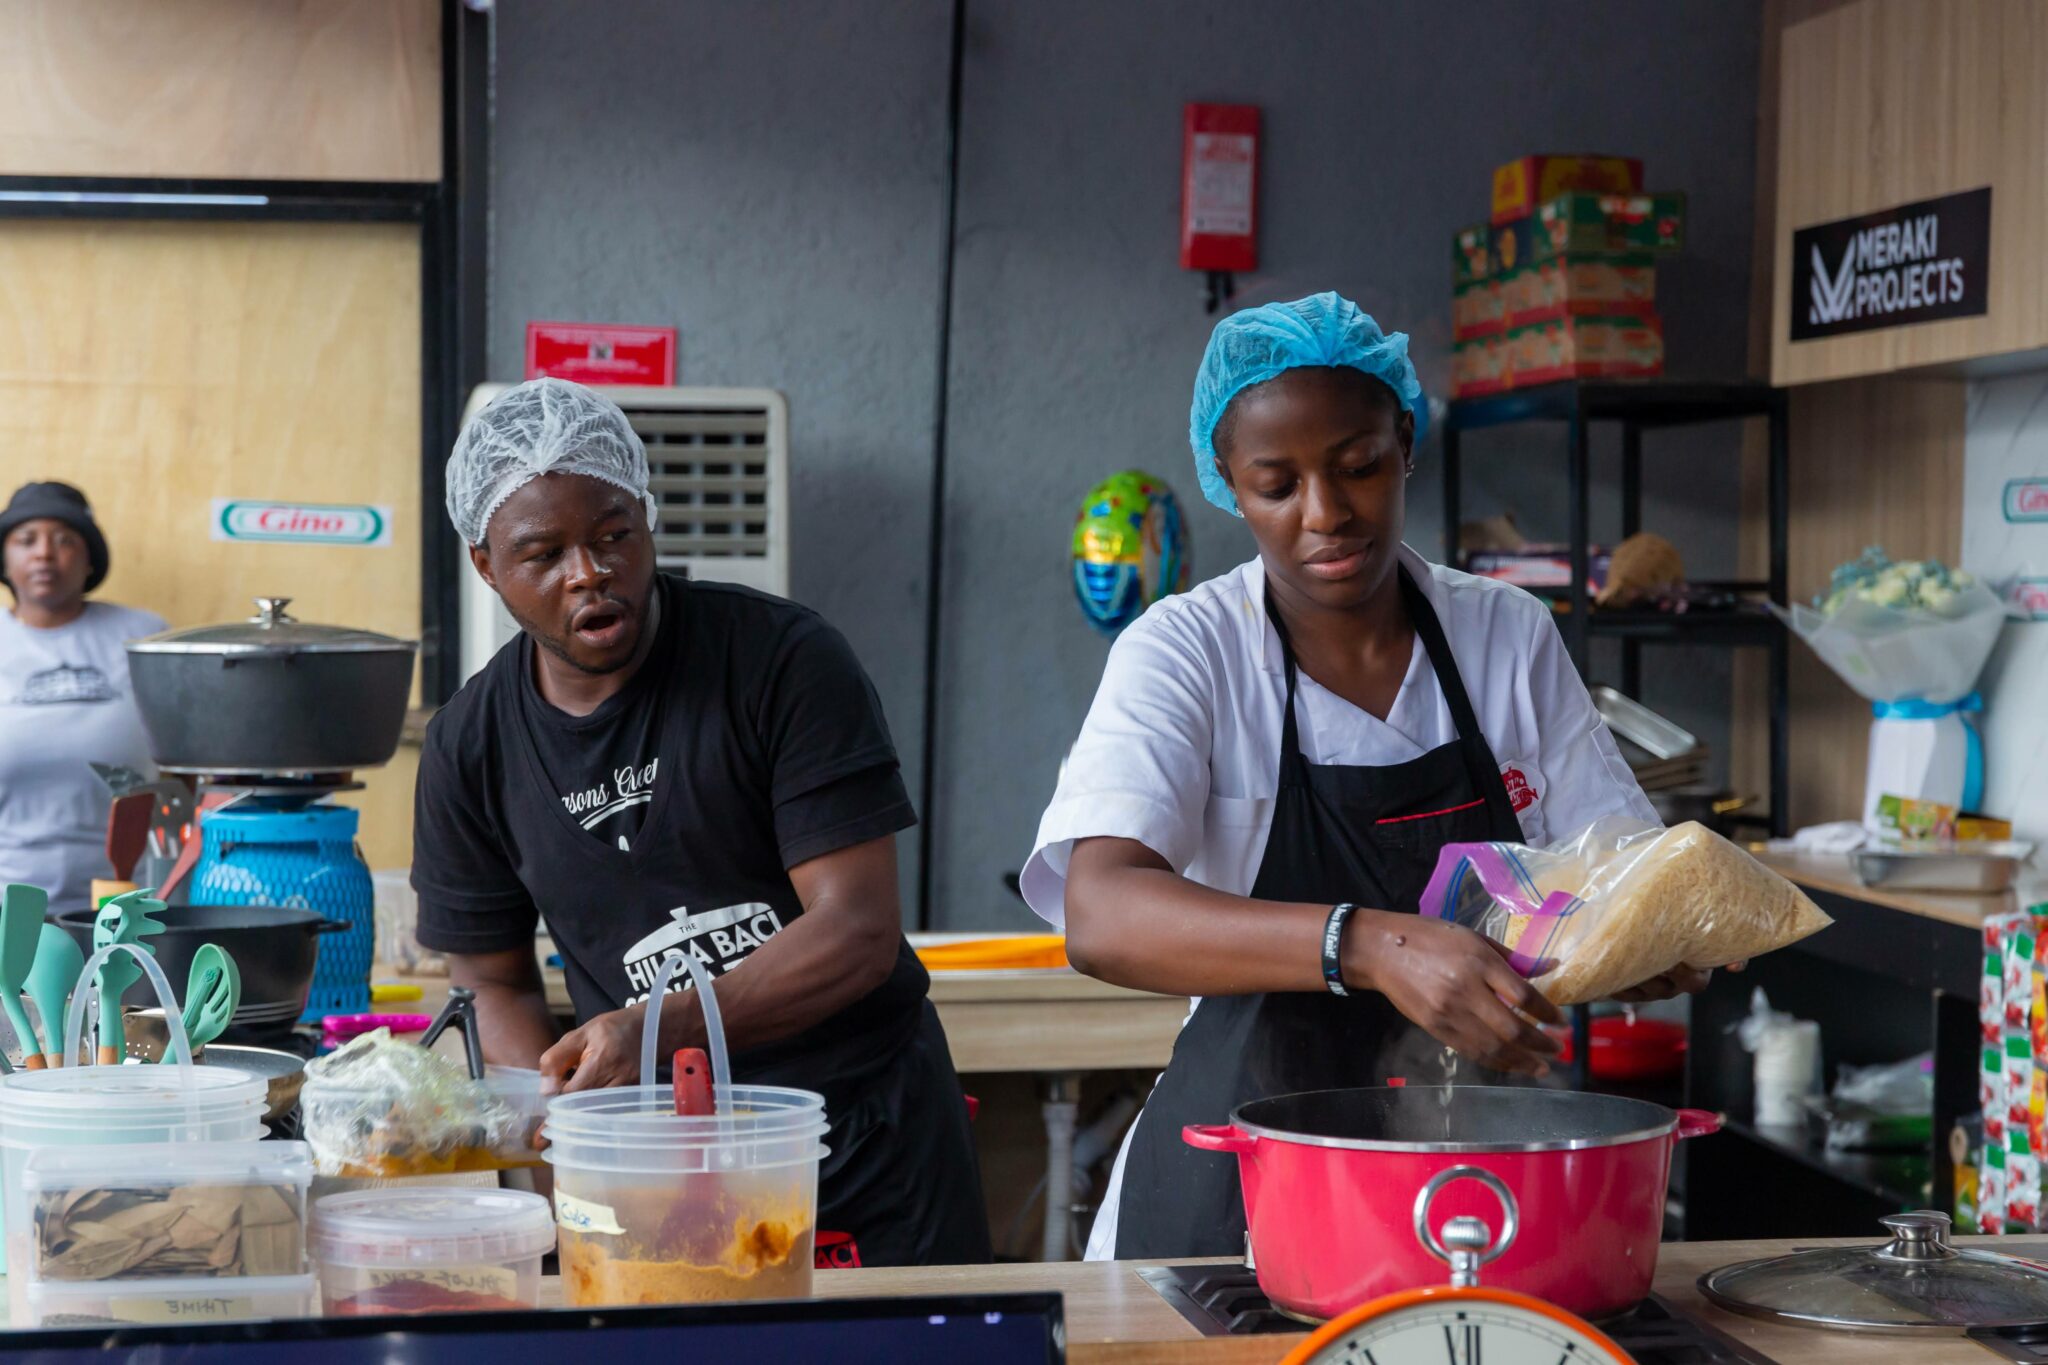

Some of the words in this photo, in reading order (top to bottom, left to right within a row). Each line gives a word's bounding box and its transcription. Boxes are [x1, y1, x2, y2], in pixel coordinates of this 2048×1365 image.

[1856, 214, 1938, 272] MERAKI
[1855, 257, 1964, 318] PROJECTS
[258, 505, 344, 533] Gino
[624, 938, 714, 992] HILDA
[709, 909, 783, 958] BACI
[678, 922, 697, 934] THE
